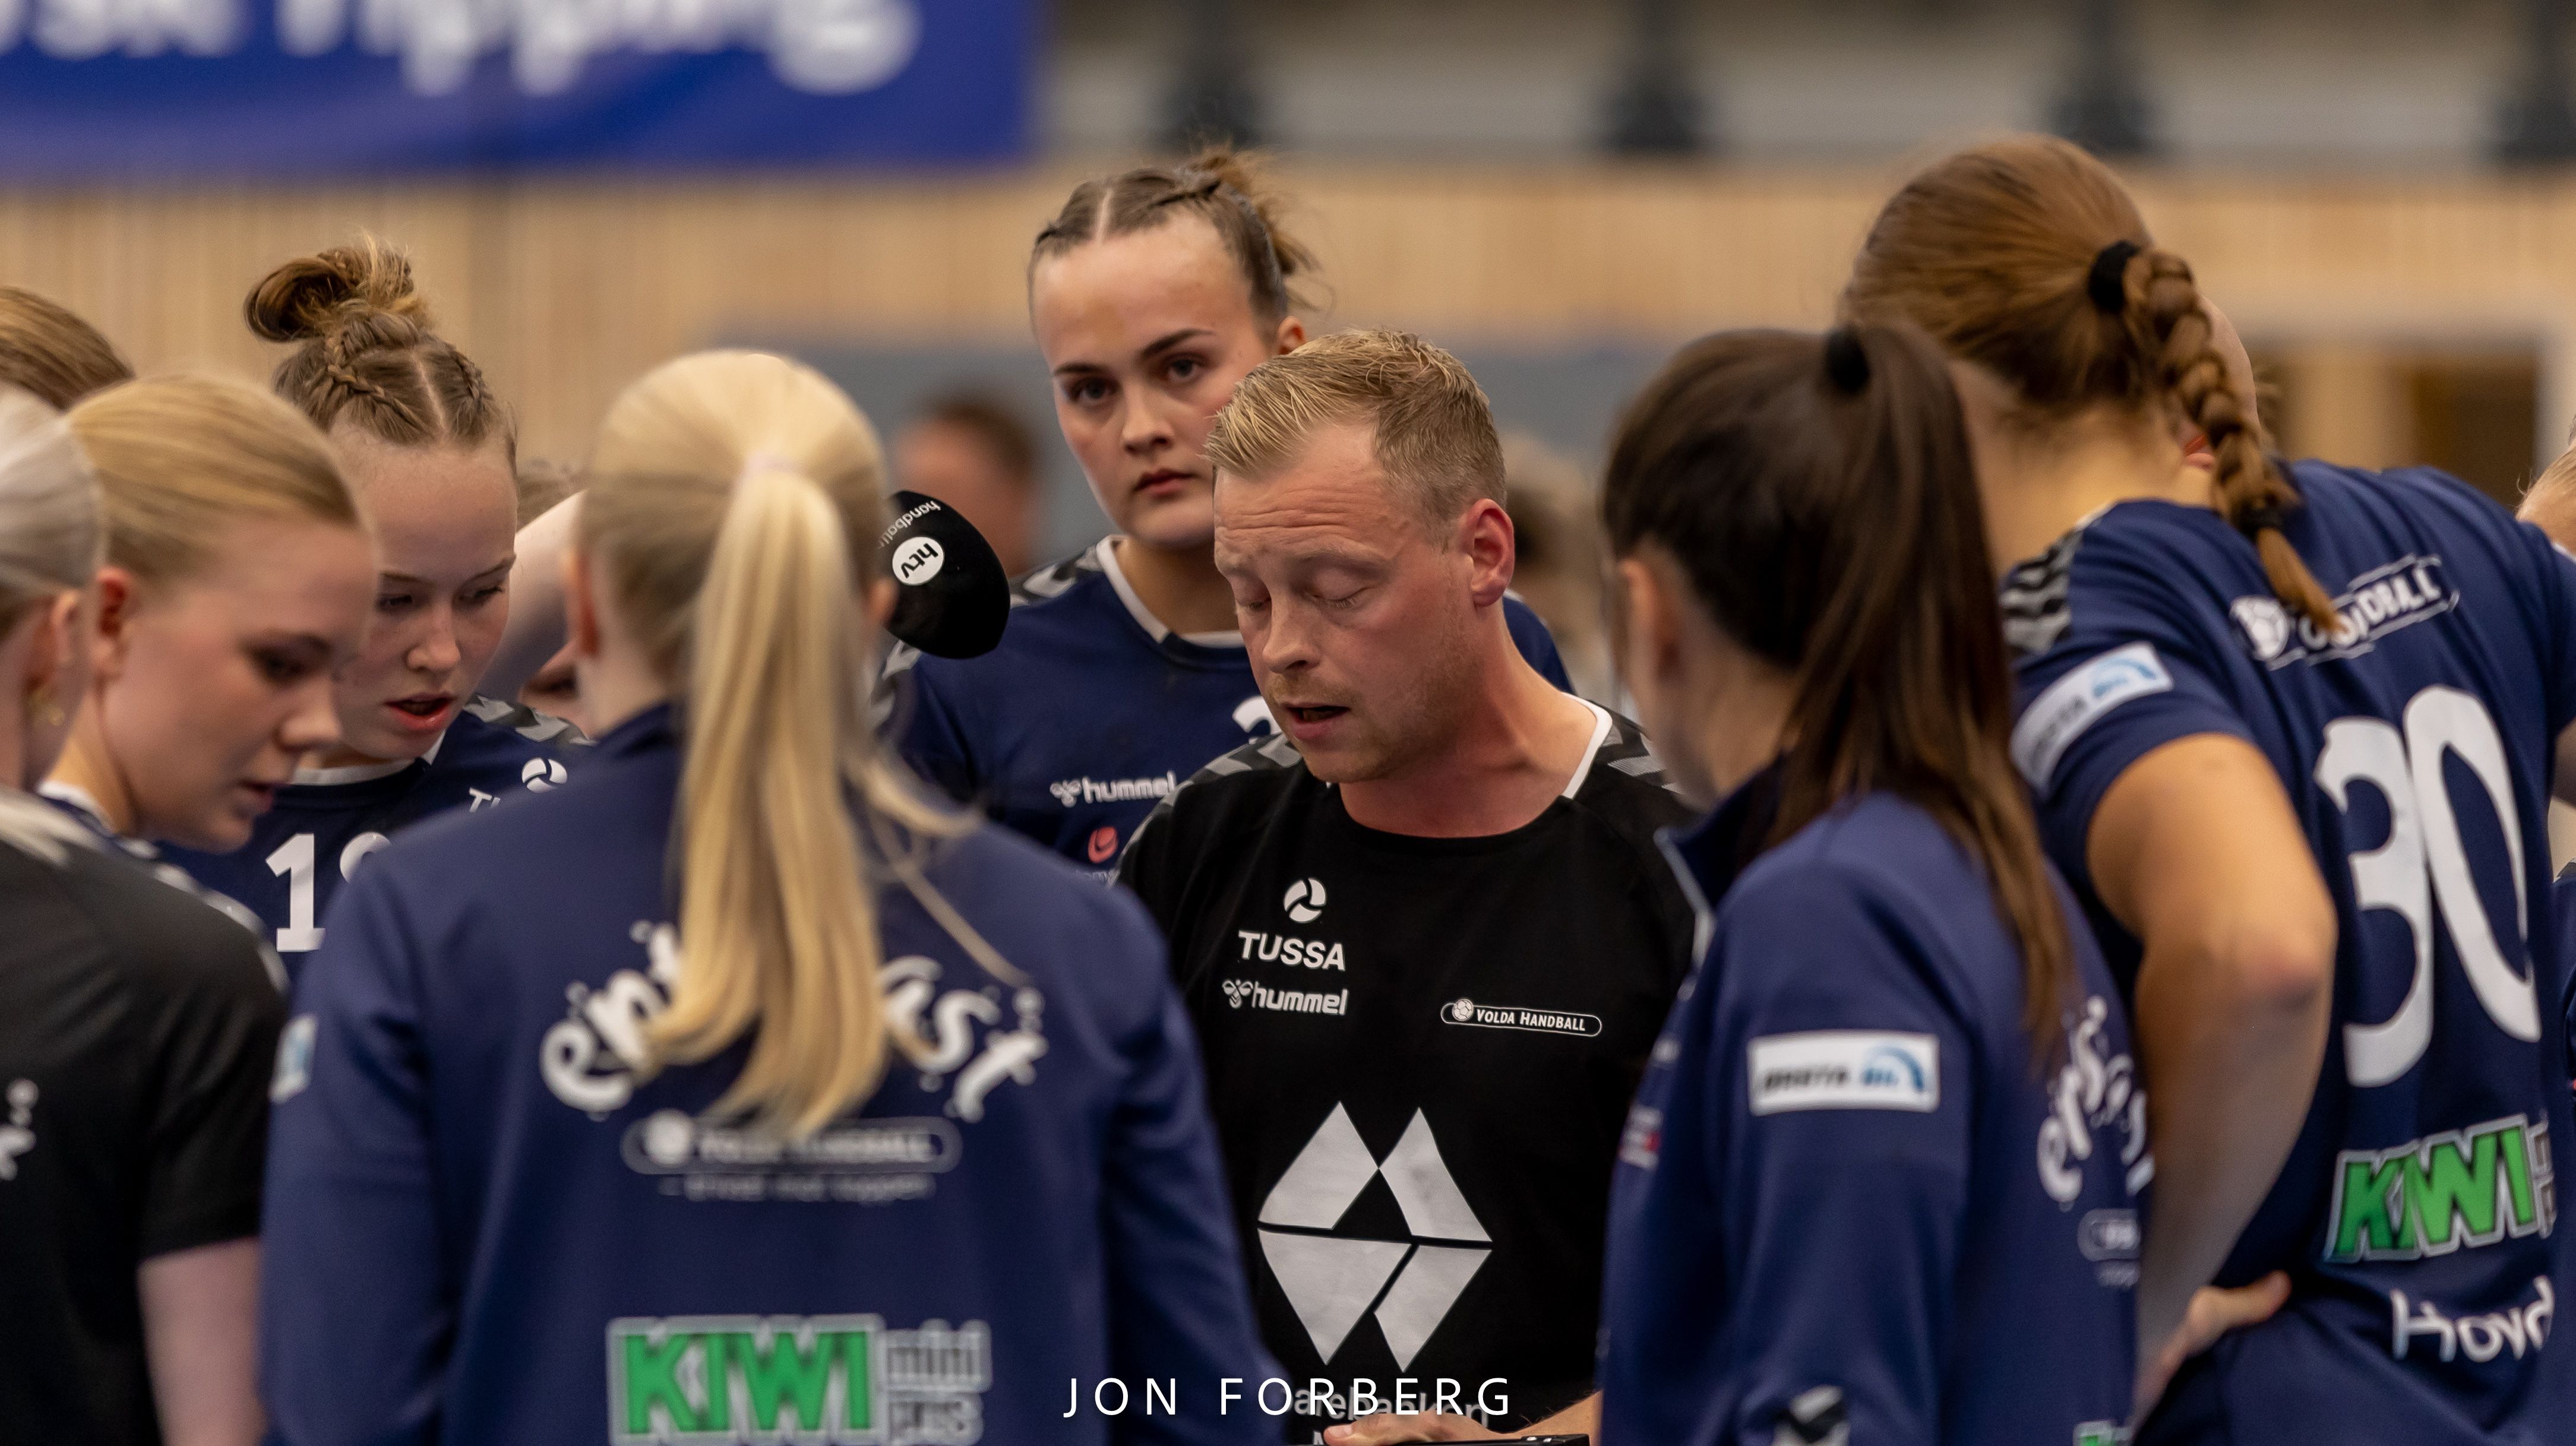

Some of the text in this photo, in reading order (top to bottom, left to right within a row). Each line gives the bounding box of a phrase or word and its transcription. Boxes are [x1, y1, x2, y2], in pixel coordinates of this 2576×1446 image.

[900, 543, 939, 579] htv
[1082, 770, 1176, 804] hummel
[2313, 684, 2541, 1087] 30
[1238, 930, 1346, 972] TUSSA
[1251, 981, 1348, 1016] hummel
[1477, 1009, 1586, 1031] VOLDA HANDBALL
[619, 1324, 877, 1439] KIWI
